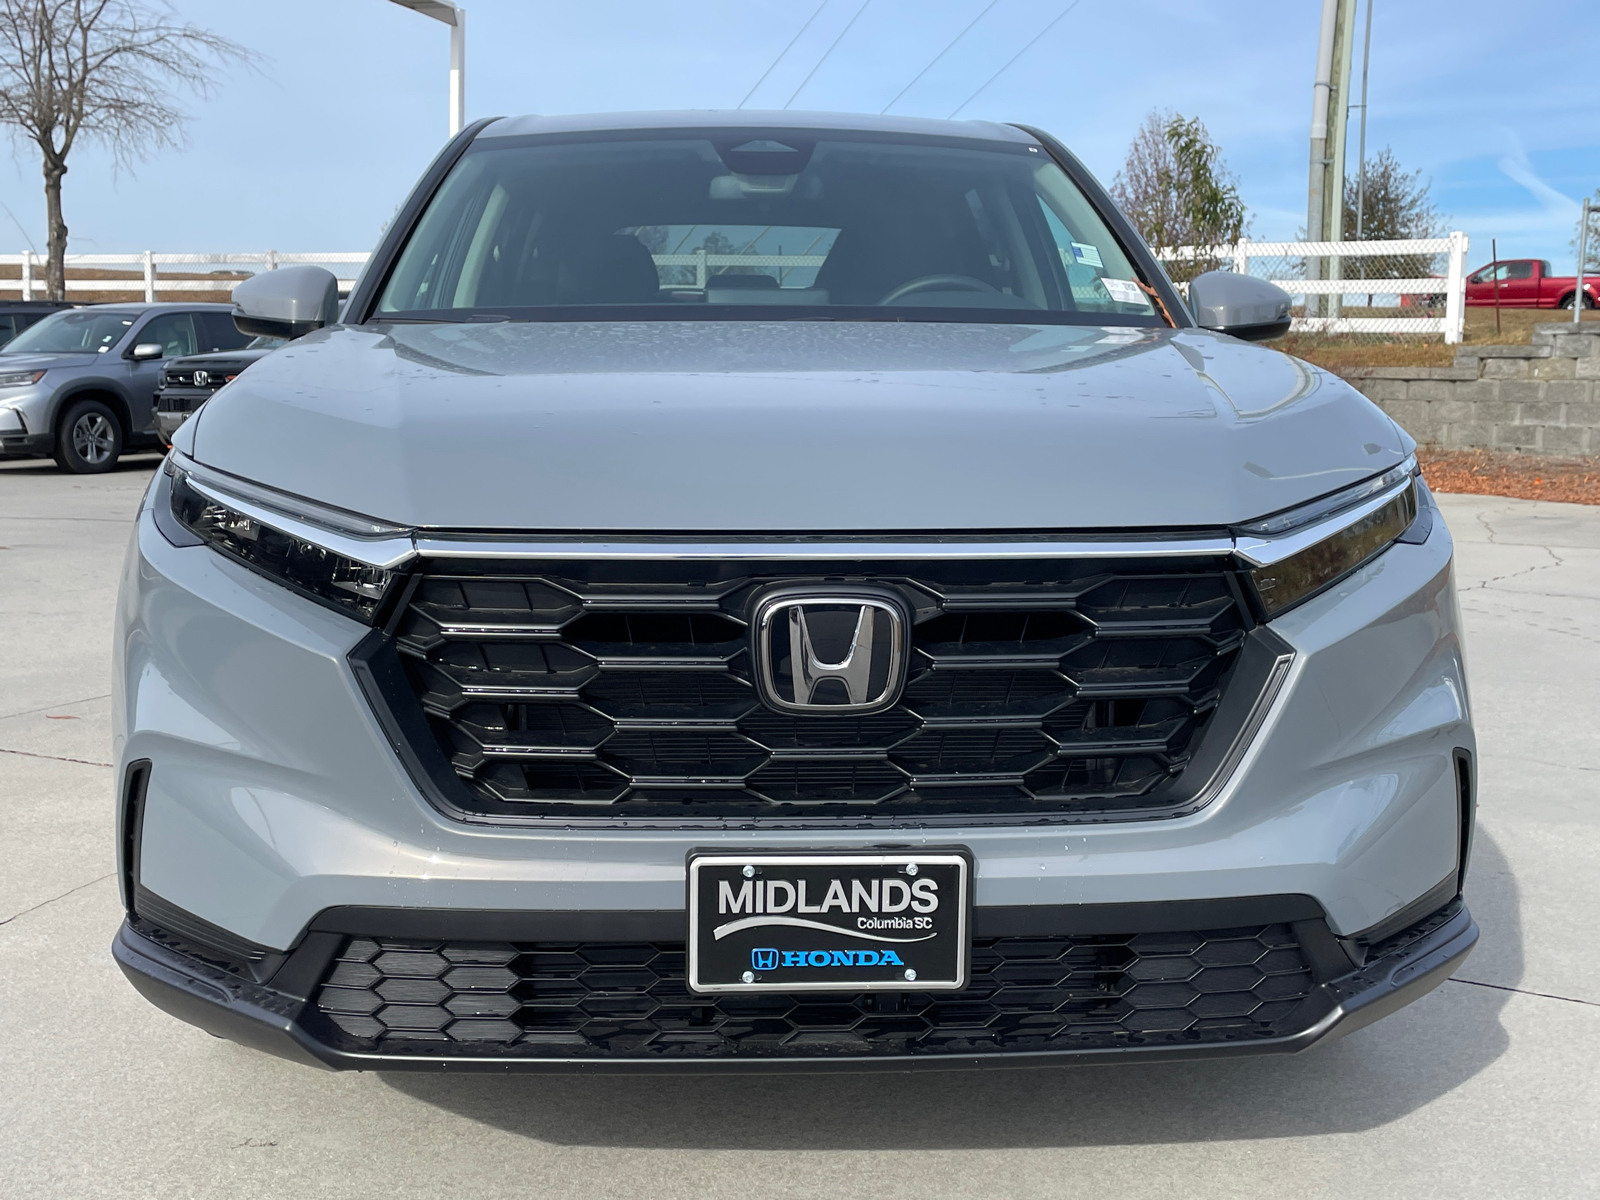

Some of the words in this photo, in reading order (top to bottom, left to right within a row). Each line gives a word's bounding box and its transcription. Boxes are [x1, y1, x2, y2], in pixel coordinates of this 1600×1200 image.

[718, 878, 939, 914] MIDLANDS
[857, 917, 914, 930] Columbia
[914, 917, 933, 930] SC
[781, 950, 904, 967] HONDA
